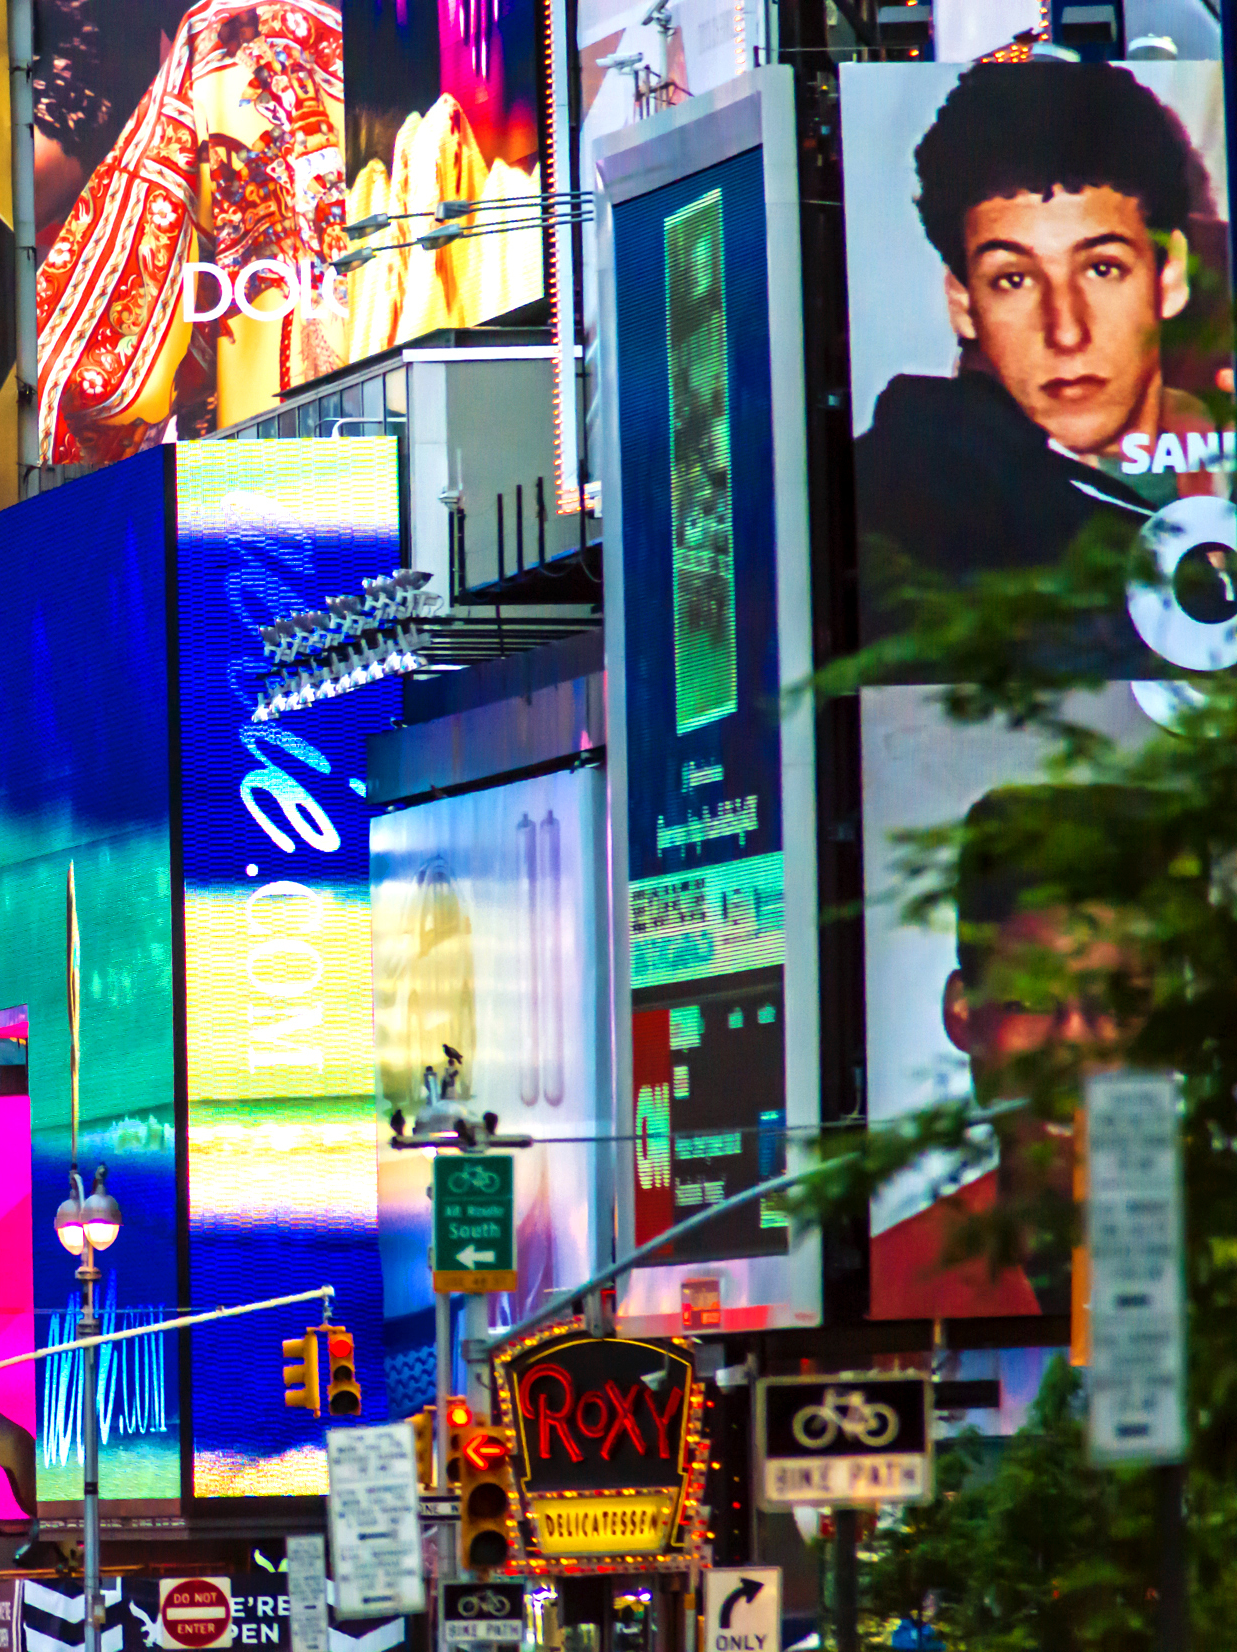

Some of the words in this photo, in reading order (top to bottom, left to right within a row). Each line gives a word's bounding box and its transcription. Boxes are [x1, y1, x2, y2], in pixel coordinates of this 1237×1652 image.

[449, 1222, 501, 1239] South
[545, 1510, 658, 1537] DELICATESSEN
[173, 1593, 190, 1604] DO
[194, 1592, 217, 1603] NOT
[231, 1595, 290, 1617] E'RE
[177, 1623, 216, 1635] ENTER
[231, 1622, 279, 1644] EN
[715, 1634, 767, 1651] ONLY
